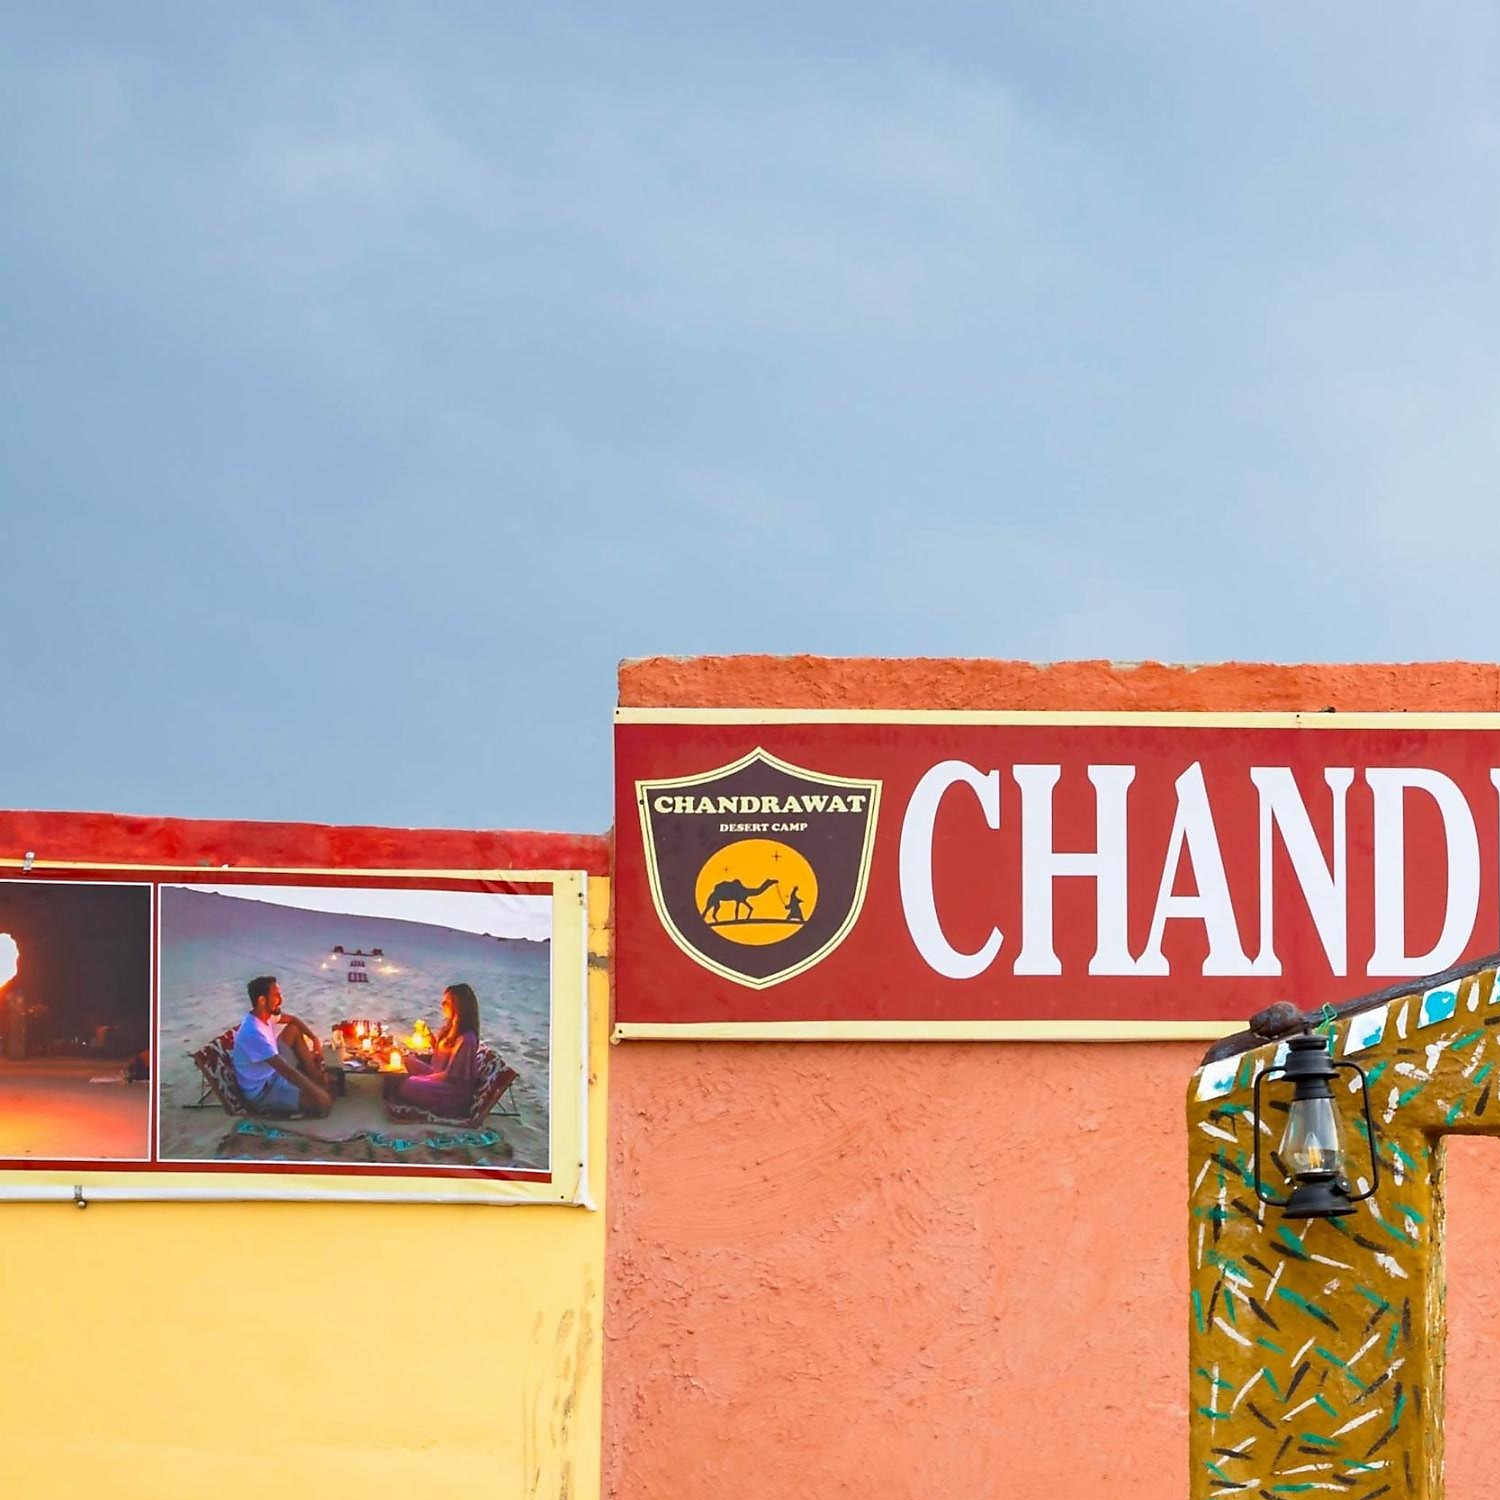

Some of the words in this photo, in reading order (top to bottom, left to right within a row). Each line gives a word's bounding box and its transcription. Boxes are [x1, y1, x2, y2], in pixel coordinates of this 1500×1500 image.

[653, 795, 866, 814] CHANDRAWAT
[719, 823, 768, 832] DESERT
[771, 822, 808, 832] CAMP
